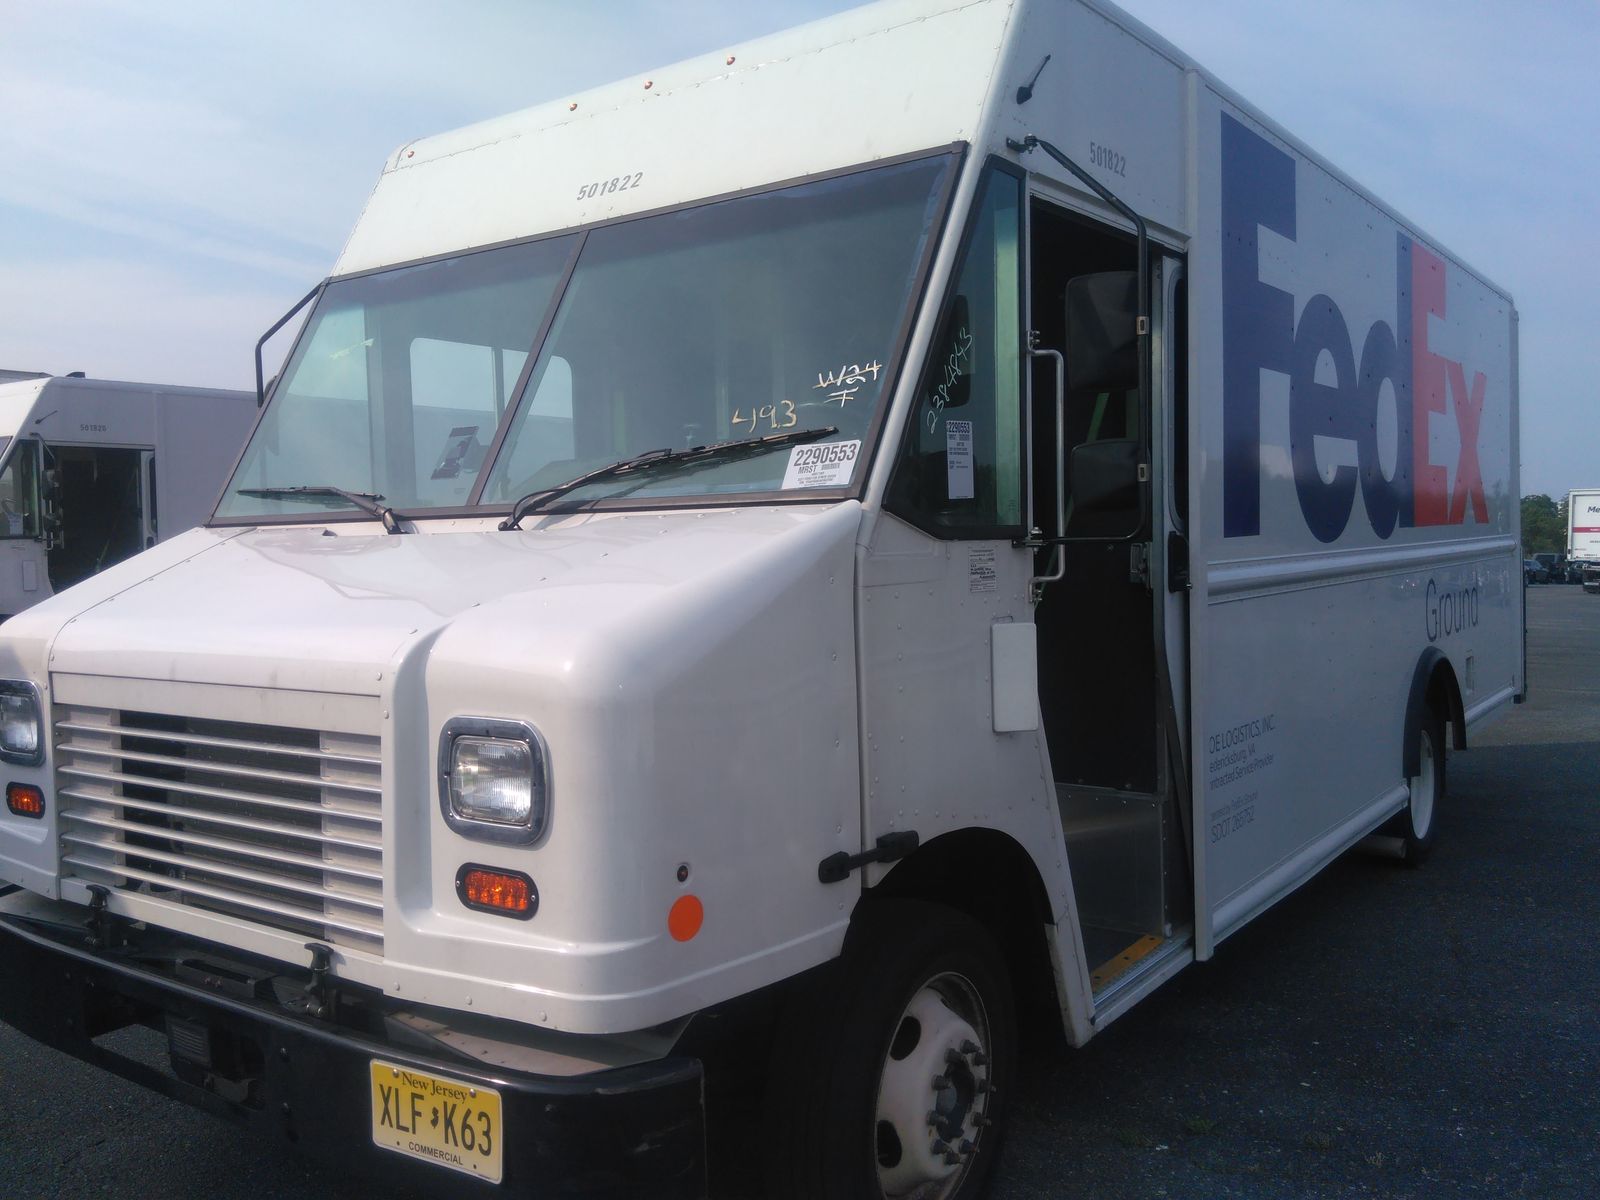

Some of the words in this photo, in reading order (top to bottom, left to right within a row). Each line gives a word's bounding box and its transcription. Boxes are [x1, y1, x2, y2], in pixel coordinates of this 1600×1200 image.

[1090, 141, 1126, 178] 501822
[577, 171, 643, 201] 501822
[1220, 110, 1489, 543] FedEx
[926, 327, 973, 434] 2384843
[793, 443, 857, 467] 2290553
[1426, 571, 1479, 642] Ground
[401, 1072, 430, 1091] New
[430, 1080, 468, 1104] Jersey
[380, 1084, 425, 1135] XLF
[443, 1101, 492, 1157] K63
[408, 1141, 464, 1166] COMMERCIAL
